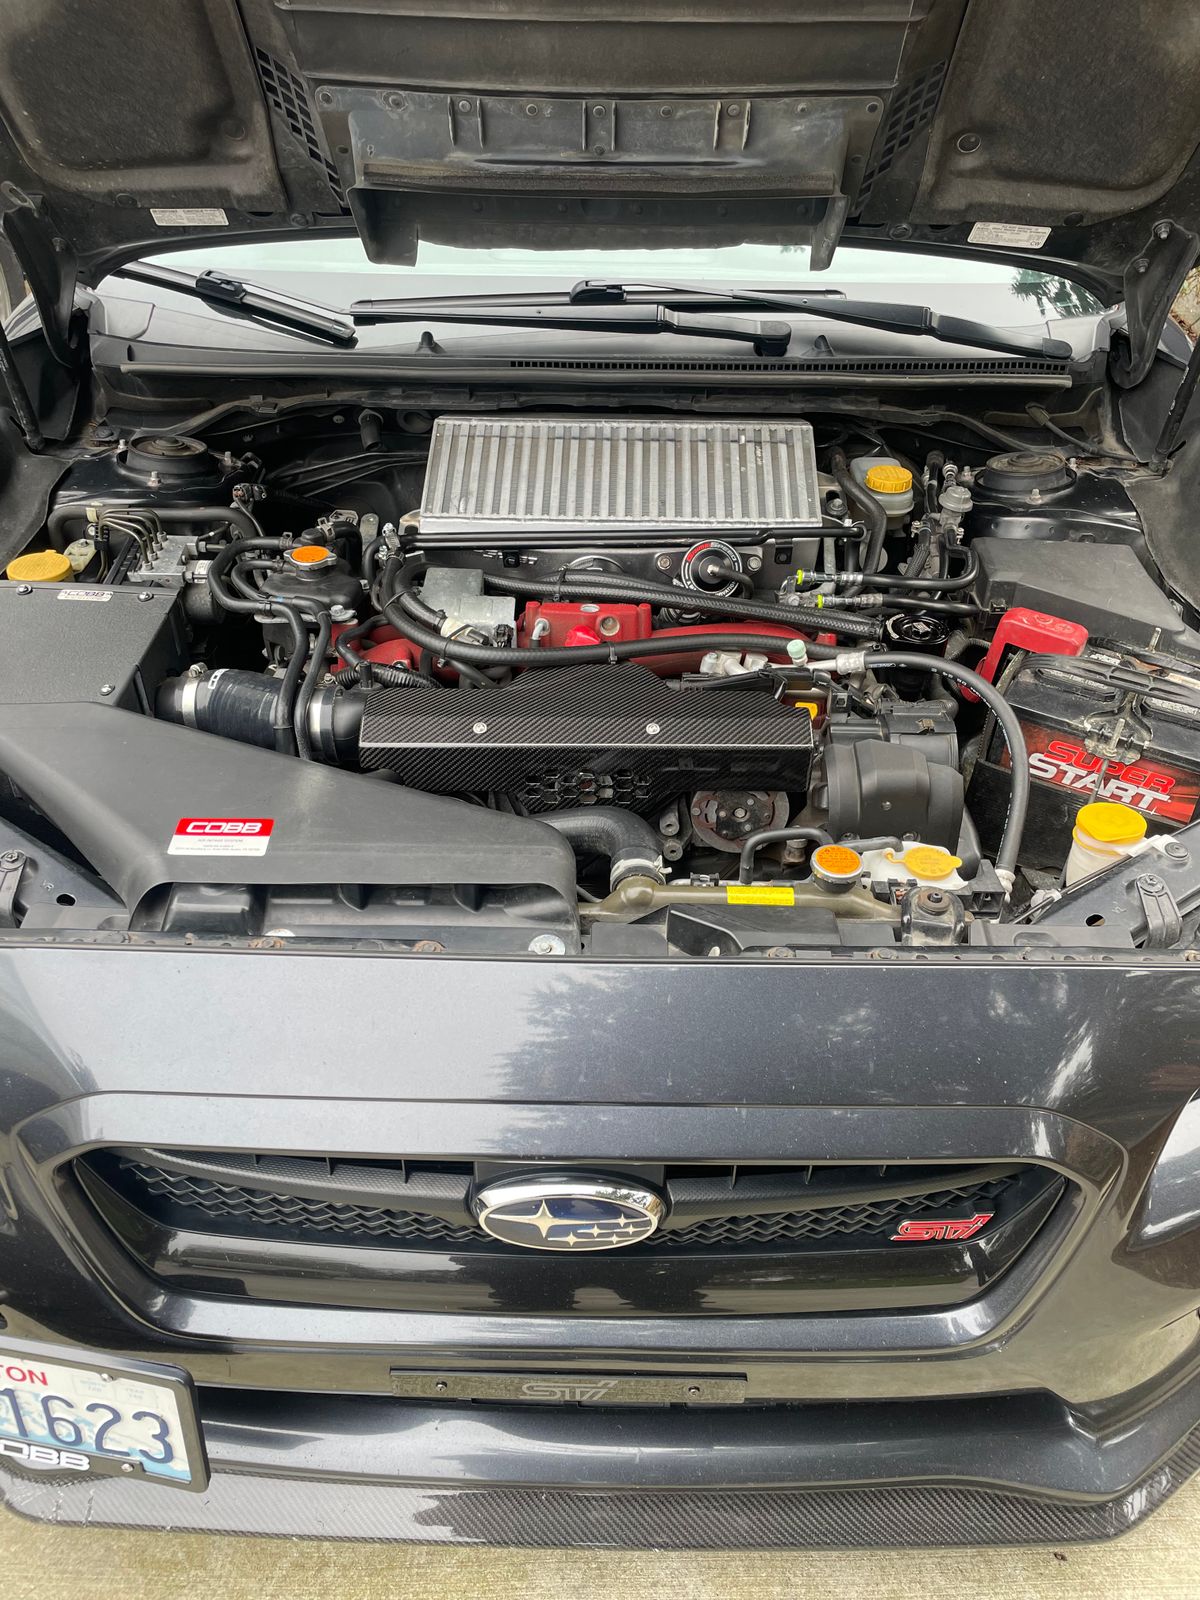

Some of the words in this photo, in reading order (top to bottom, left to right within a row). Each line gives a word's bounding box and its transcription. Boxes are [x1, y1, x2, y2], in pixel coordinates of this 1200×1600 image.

[1028, 752, 1171, 809] START
[1044, 740, 1176, 795] SUPER
[186, 821, 263, 834] COBB
[0, 1387, 174, 1464] 1623
